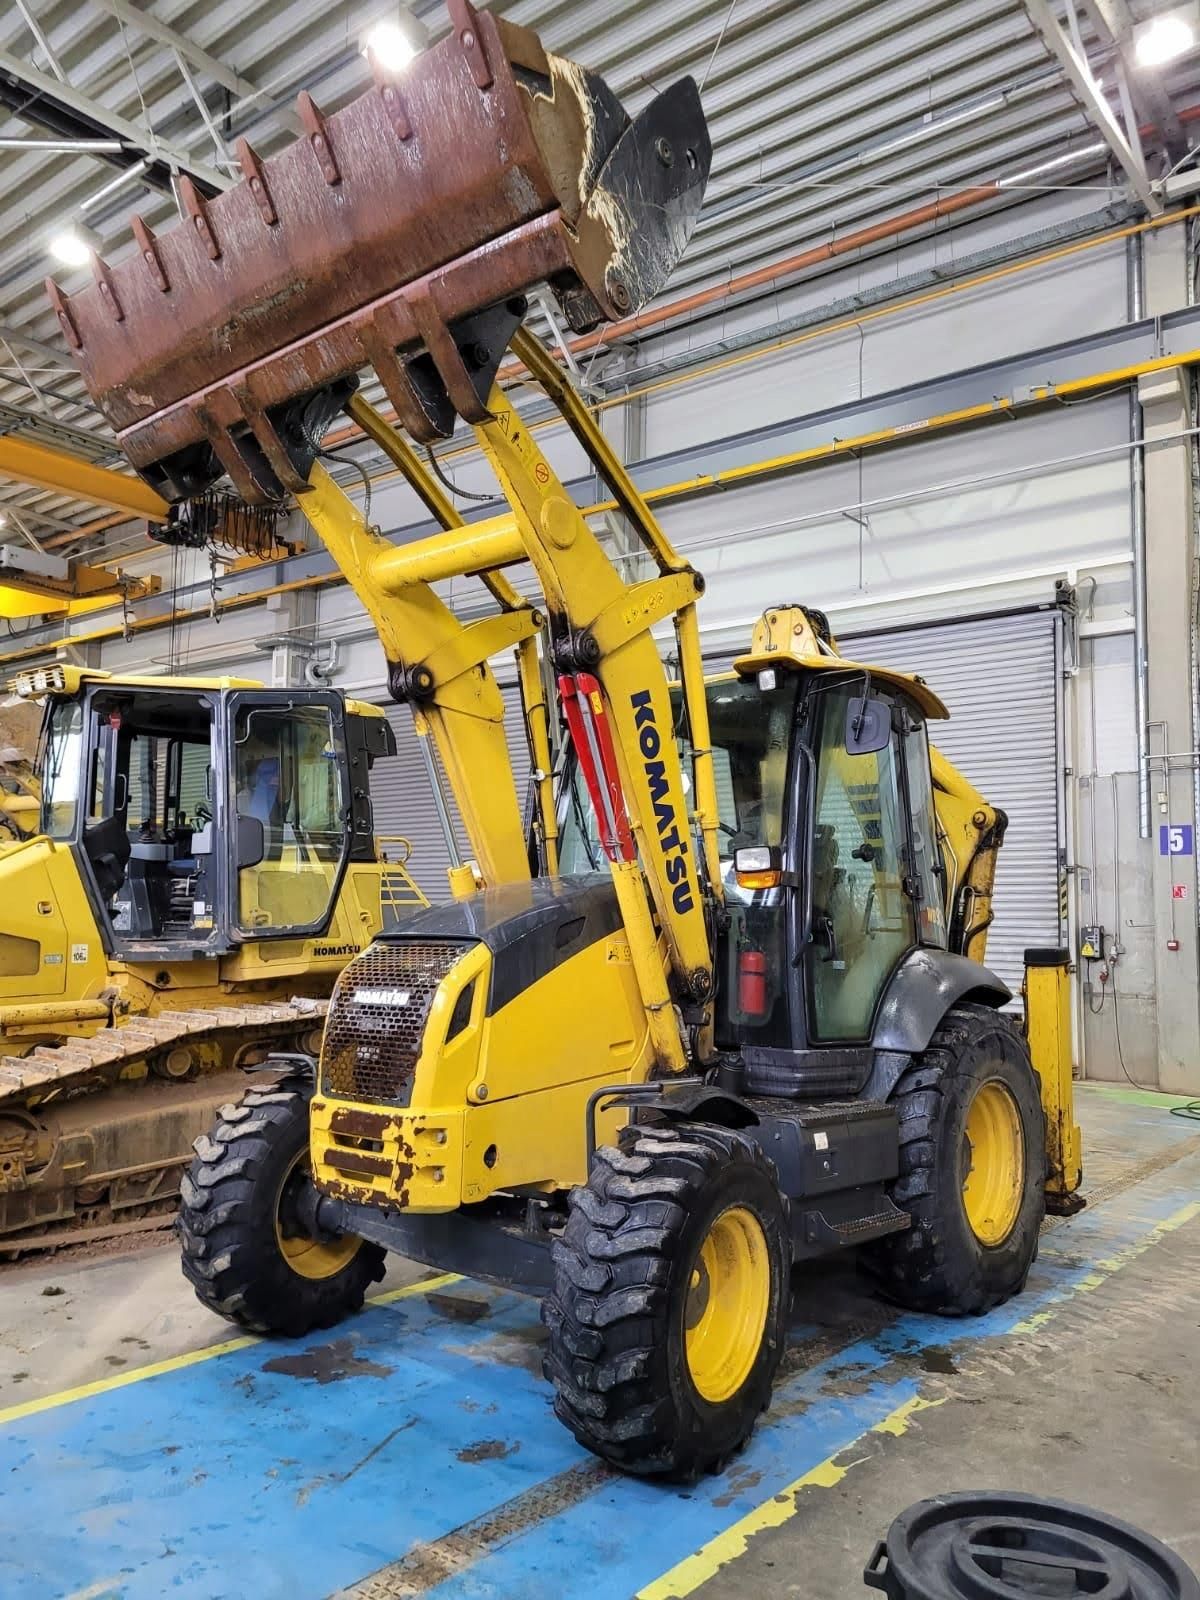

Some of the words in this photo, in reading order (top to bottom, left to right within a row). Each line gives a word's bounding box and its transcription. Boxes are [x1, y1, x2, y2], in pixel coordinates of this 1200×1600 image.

[630, 689, 694, 916] KOMATSU
[1169, 827, 1184, 852] 5
[313, 943, 361, 957] KOMATSU
[352, 988, 411, 1006] KOMATSU
